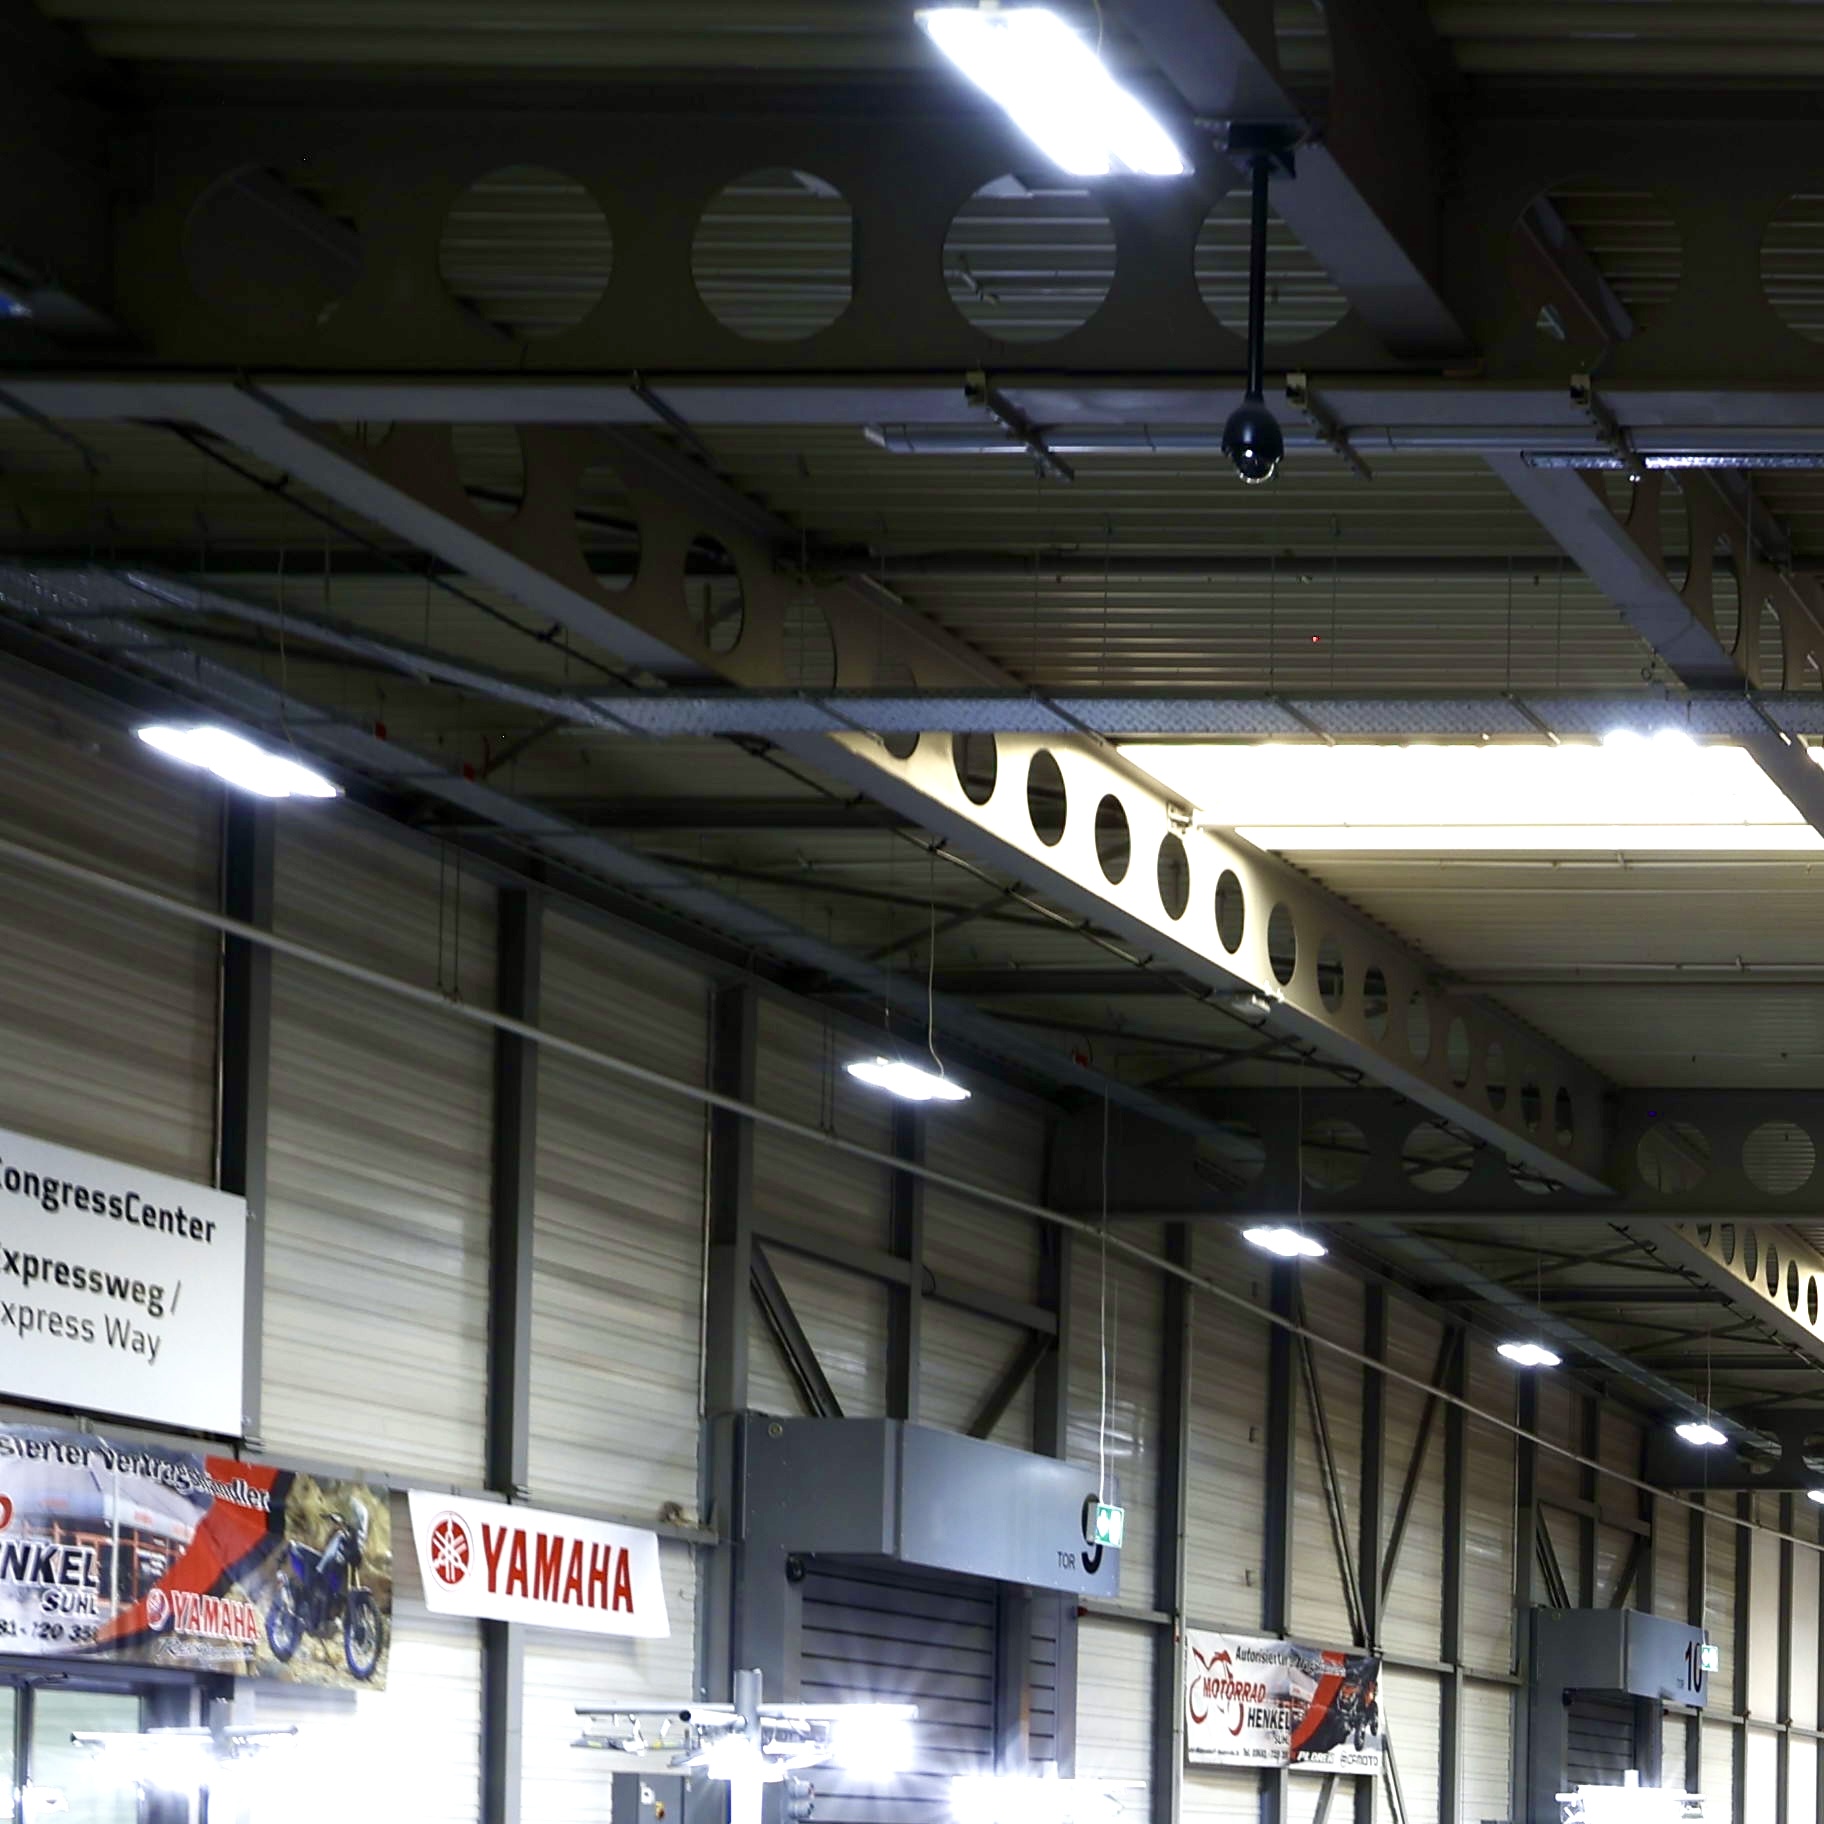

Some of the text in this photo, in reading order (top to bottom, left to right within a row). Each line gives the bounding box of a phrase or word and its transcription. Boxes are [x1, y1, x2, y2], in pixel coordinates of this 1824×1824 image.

[0, 1156, 216, 1244] ongressCenter
[0, 1243, 165, 1318] xpressweg
[104, 1313, 161, 1365] Way
[481, 1522, 635, 1615] YAMAHA
[1057, 1551, 1076, 1570] TOR
[172, 1589, 260, 1645] YAMAHA
[1203, 1677, 1266, 1703] MOTORRAD
[1685, 1640, 1703, 1693] 10
[1247, 1707, 1291, 1731] HENKEL
